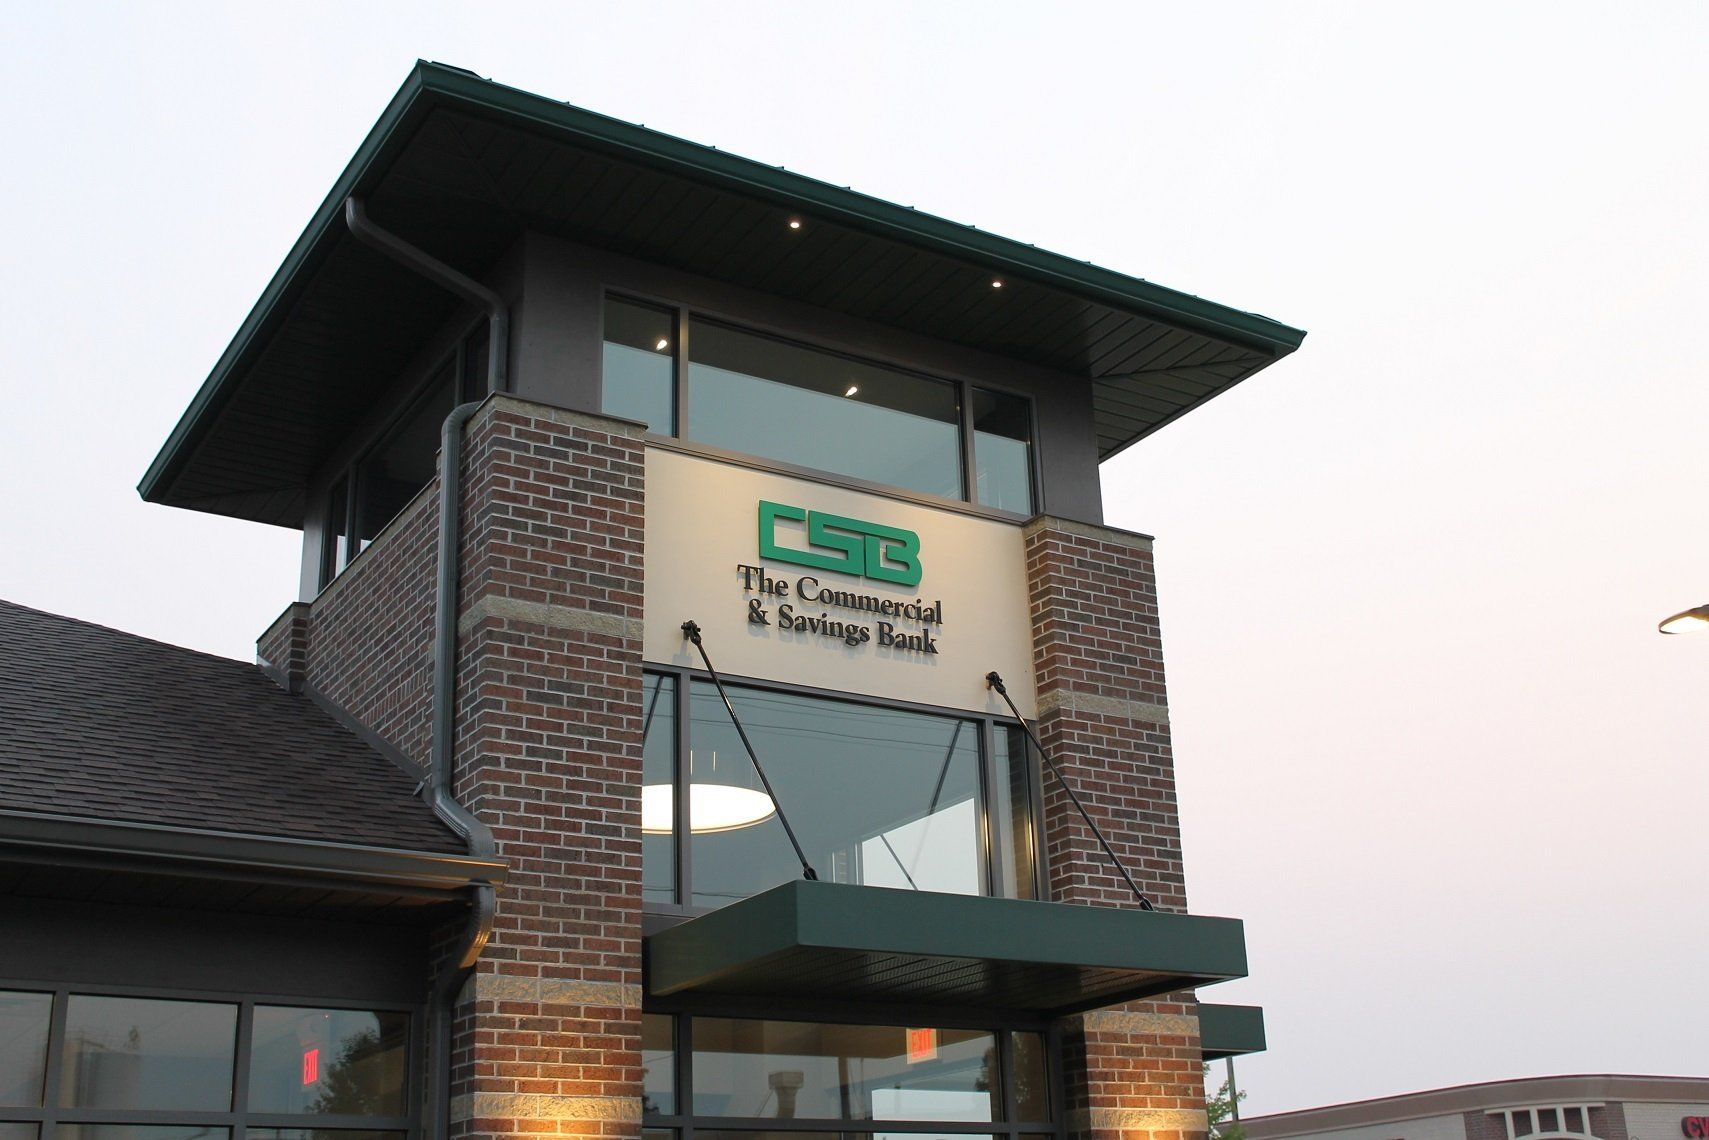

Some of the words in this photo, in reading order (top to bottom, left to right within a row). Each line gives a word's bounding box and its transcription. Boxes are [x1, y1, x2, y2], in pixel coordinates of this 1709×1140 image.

[759, 500, 922, 586] CSB
[737, 564, 789, 596] The
[797, 577, 943, 625] Commercial
[748, 598, 771, 626] &
[778, 604, 870, 647] Savings
[877, 621, 938, 654] Bank
[303, 1049, 319, 1085] EXIT
[911, 1028, 933, 1058] EXIT
